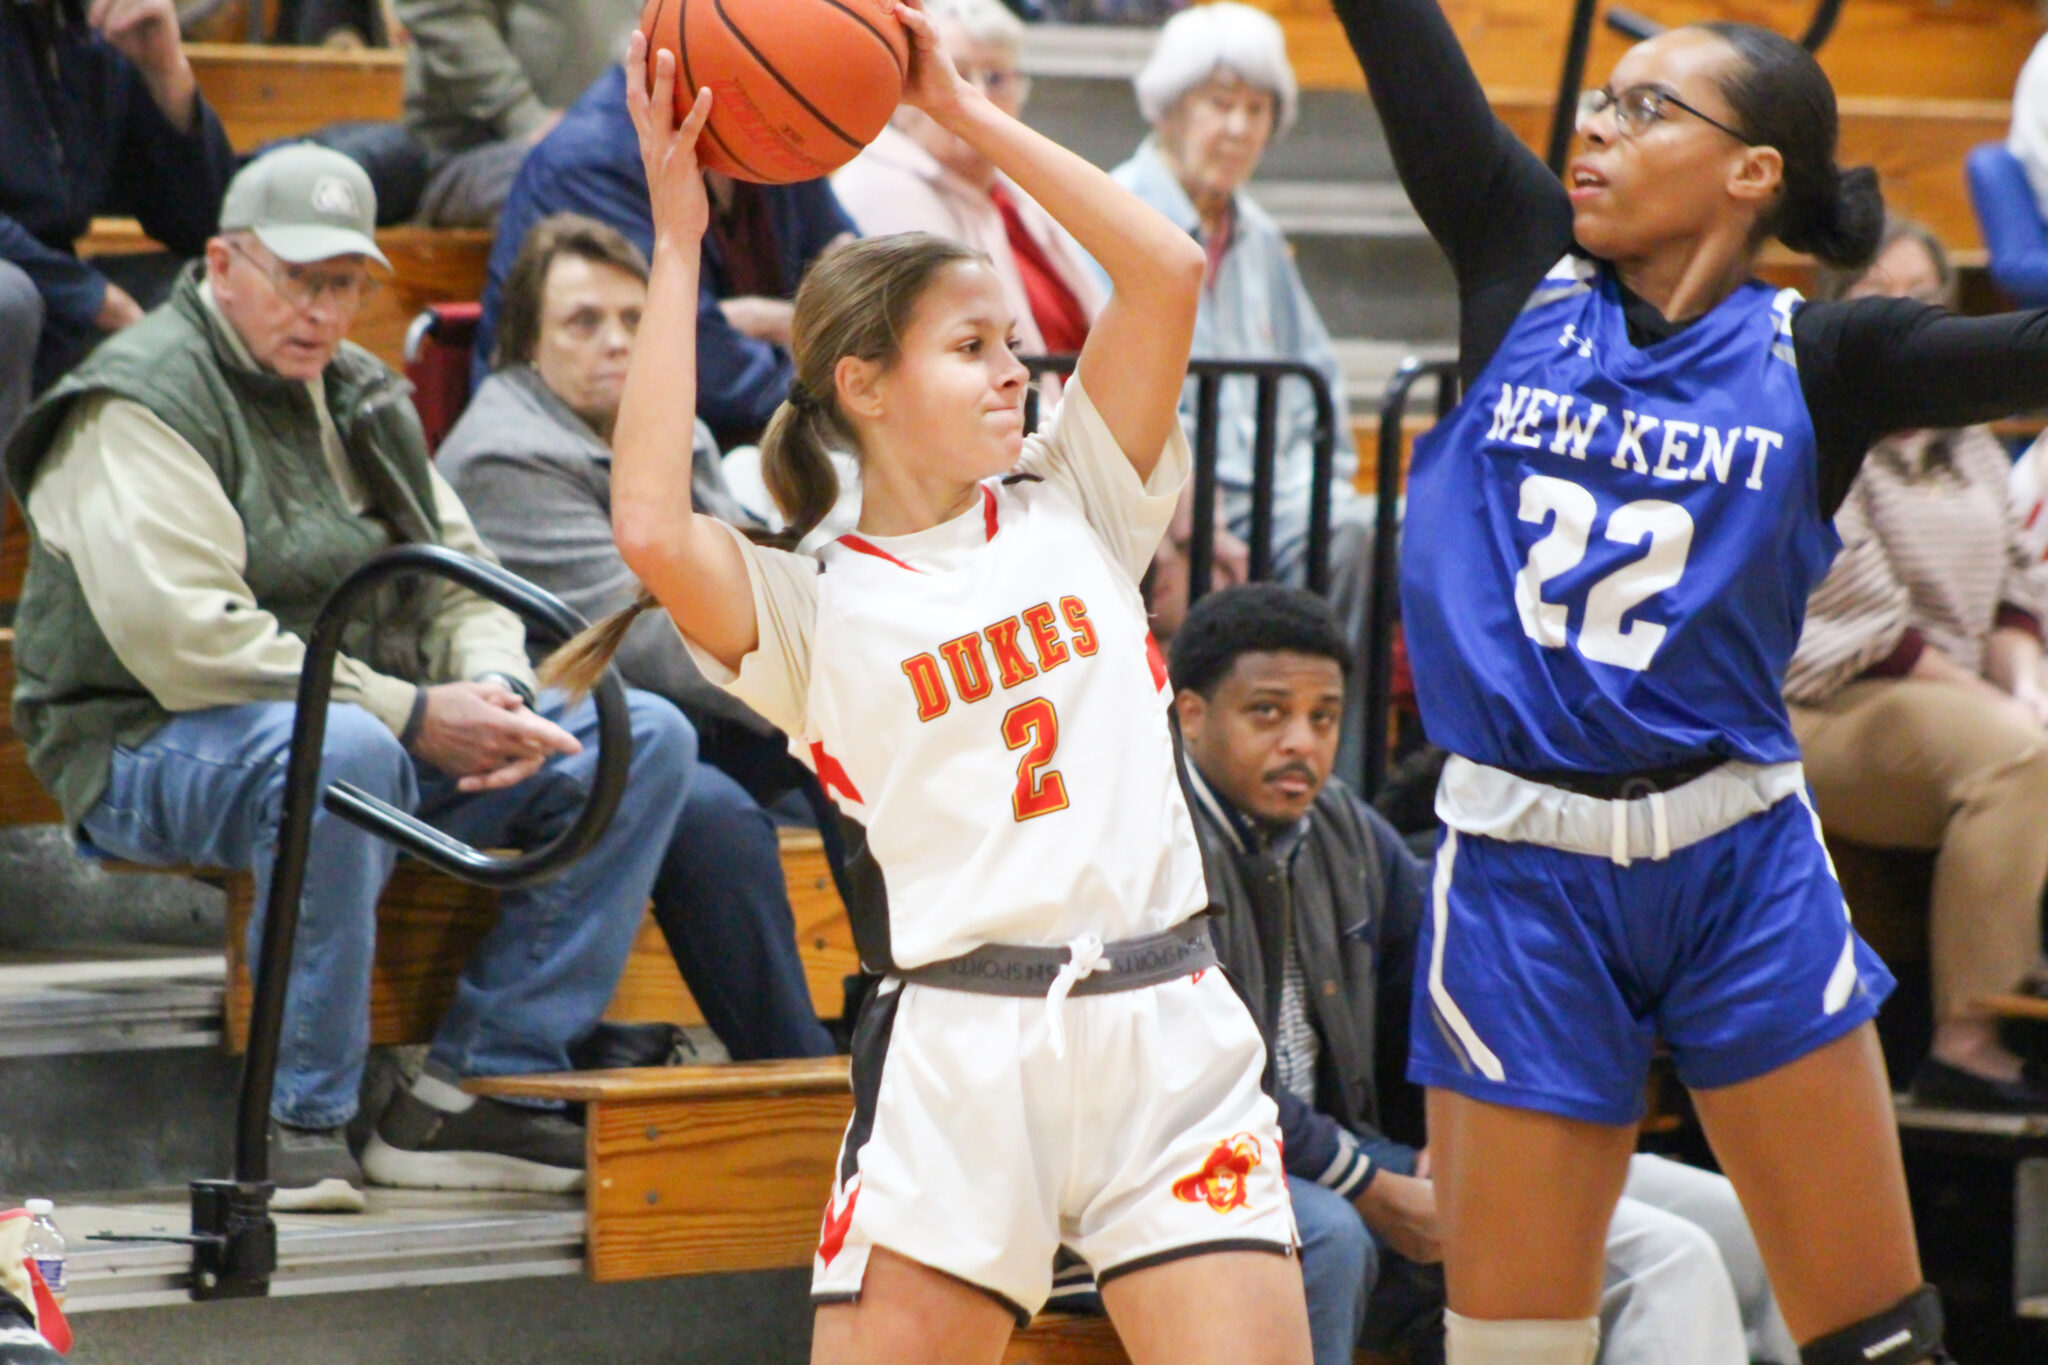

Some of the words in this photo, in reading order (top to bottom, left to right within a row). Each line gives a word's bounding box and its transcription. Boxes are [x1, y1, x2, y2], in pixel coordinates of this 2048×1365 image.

[1486, 383, 1608, 460] NEW
[1611, 409, 1784, 491] KENT
[1514, 474, 1695, 671] 22
[901, 595, 1099, 722] DUKES
[1001, 696, 1070, 822] 2
